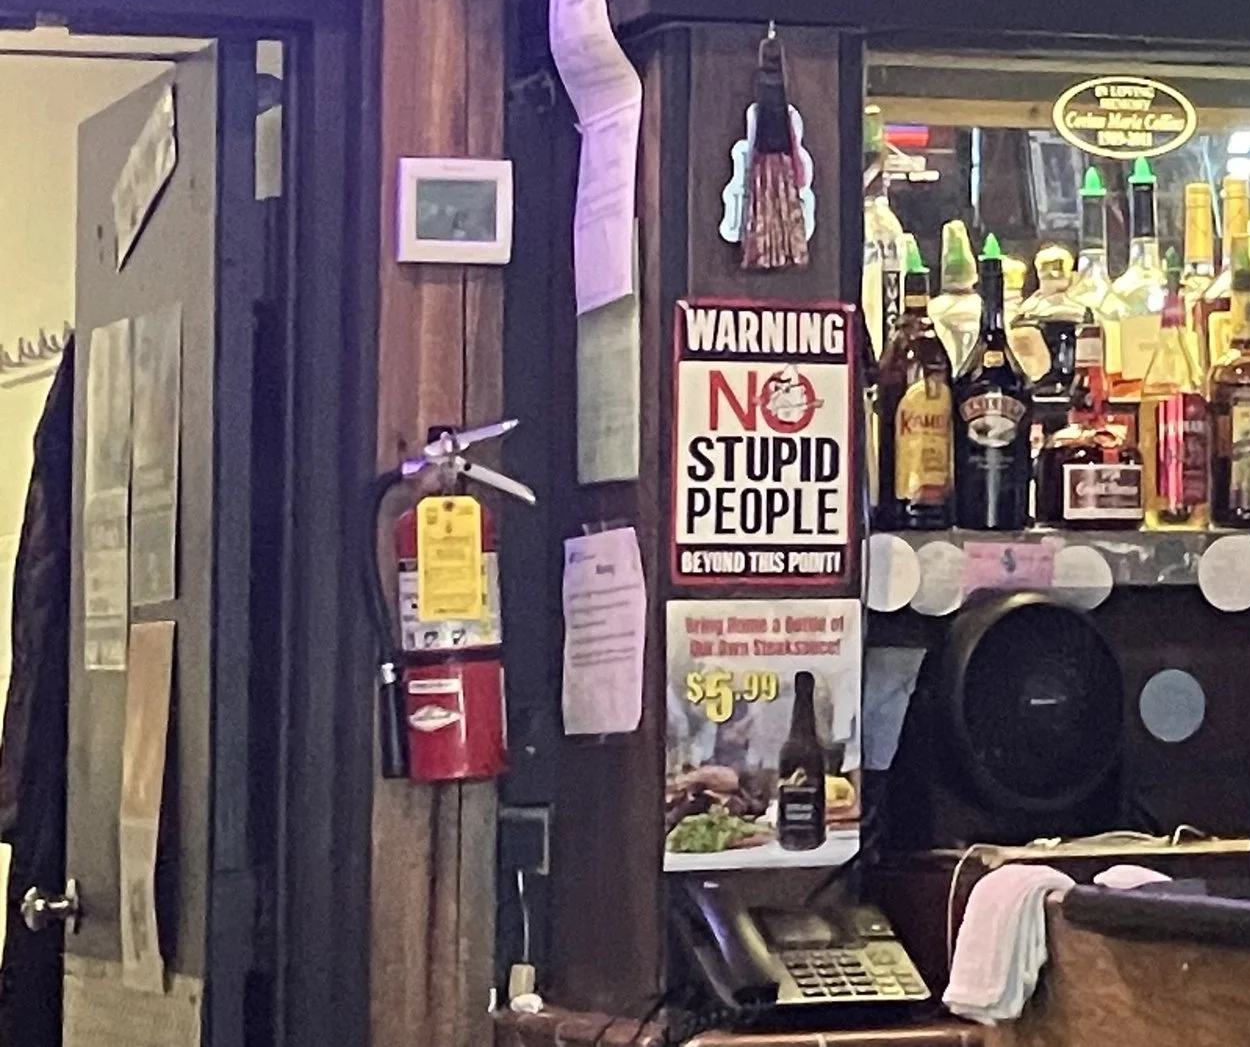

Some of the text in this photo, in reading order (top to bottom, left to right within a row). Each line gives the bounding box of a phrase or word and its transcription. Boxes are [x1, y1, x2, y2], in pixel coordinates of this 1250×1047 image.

[685, 308, 845, 355] WARNING
[708, 369, 818, 434] NO
[687, 436, 841, 483] STUPID
[686, 487, 840, 535] PEOPLE
[681, 551, 842, 574] BEYOND THIS POINT!
[685, 668, 780, 725] $5.99
